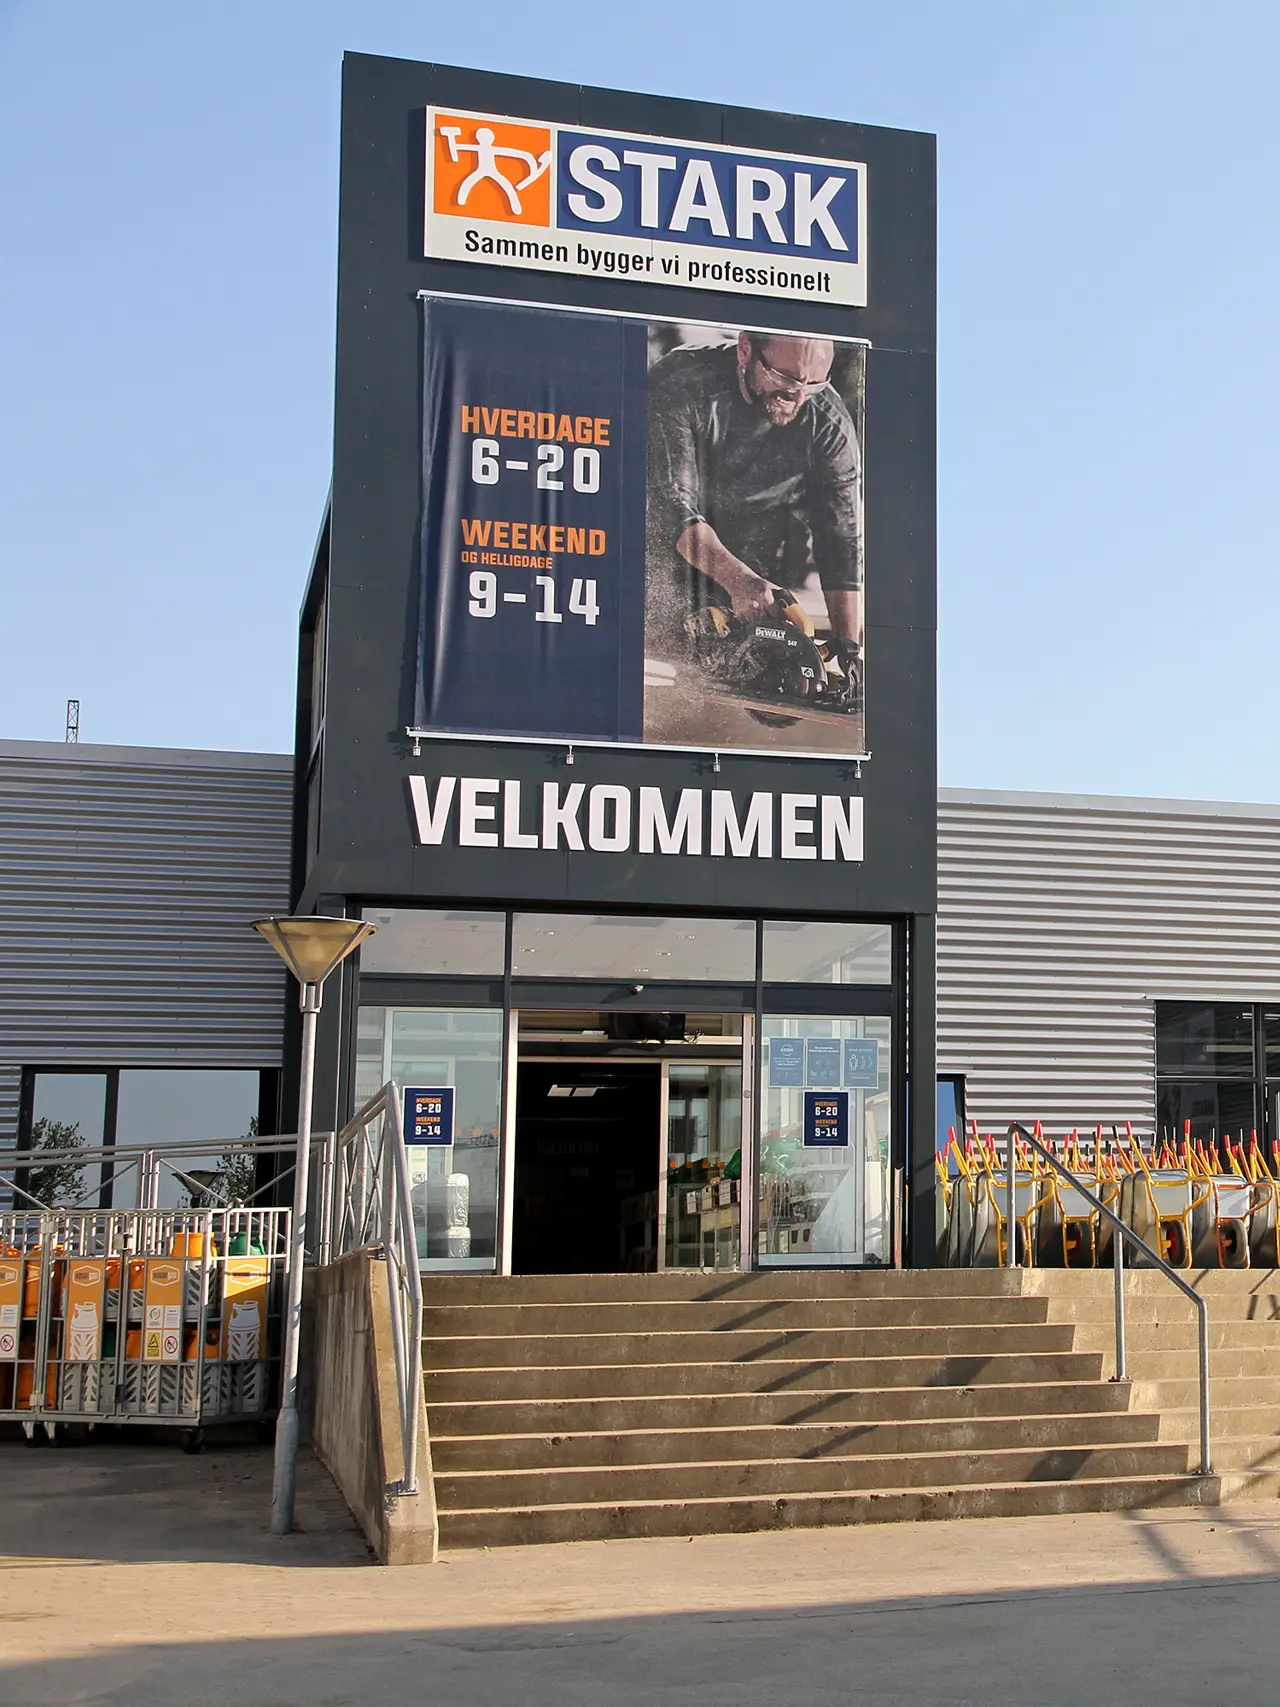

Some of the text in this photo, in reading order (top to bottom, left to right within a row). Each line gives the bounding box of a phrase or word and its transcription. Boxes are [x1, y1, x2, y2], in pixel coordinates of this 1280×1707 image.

[567, 144, 849, 252] STARK
[464, 229, 831, 293] Sammen bygger vi professionelt
[461, 405, 611, 446] HVERDAGE
[471, 438, 600, 494] 6-20
[461, 518, 606, 556] WEEKEND
[461, 551, 553, 569] OG HELLIGDAGE
[468, 571, 600, 625] 9-14
[408, 774, 864, 862] VELKOMMEN
